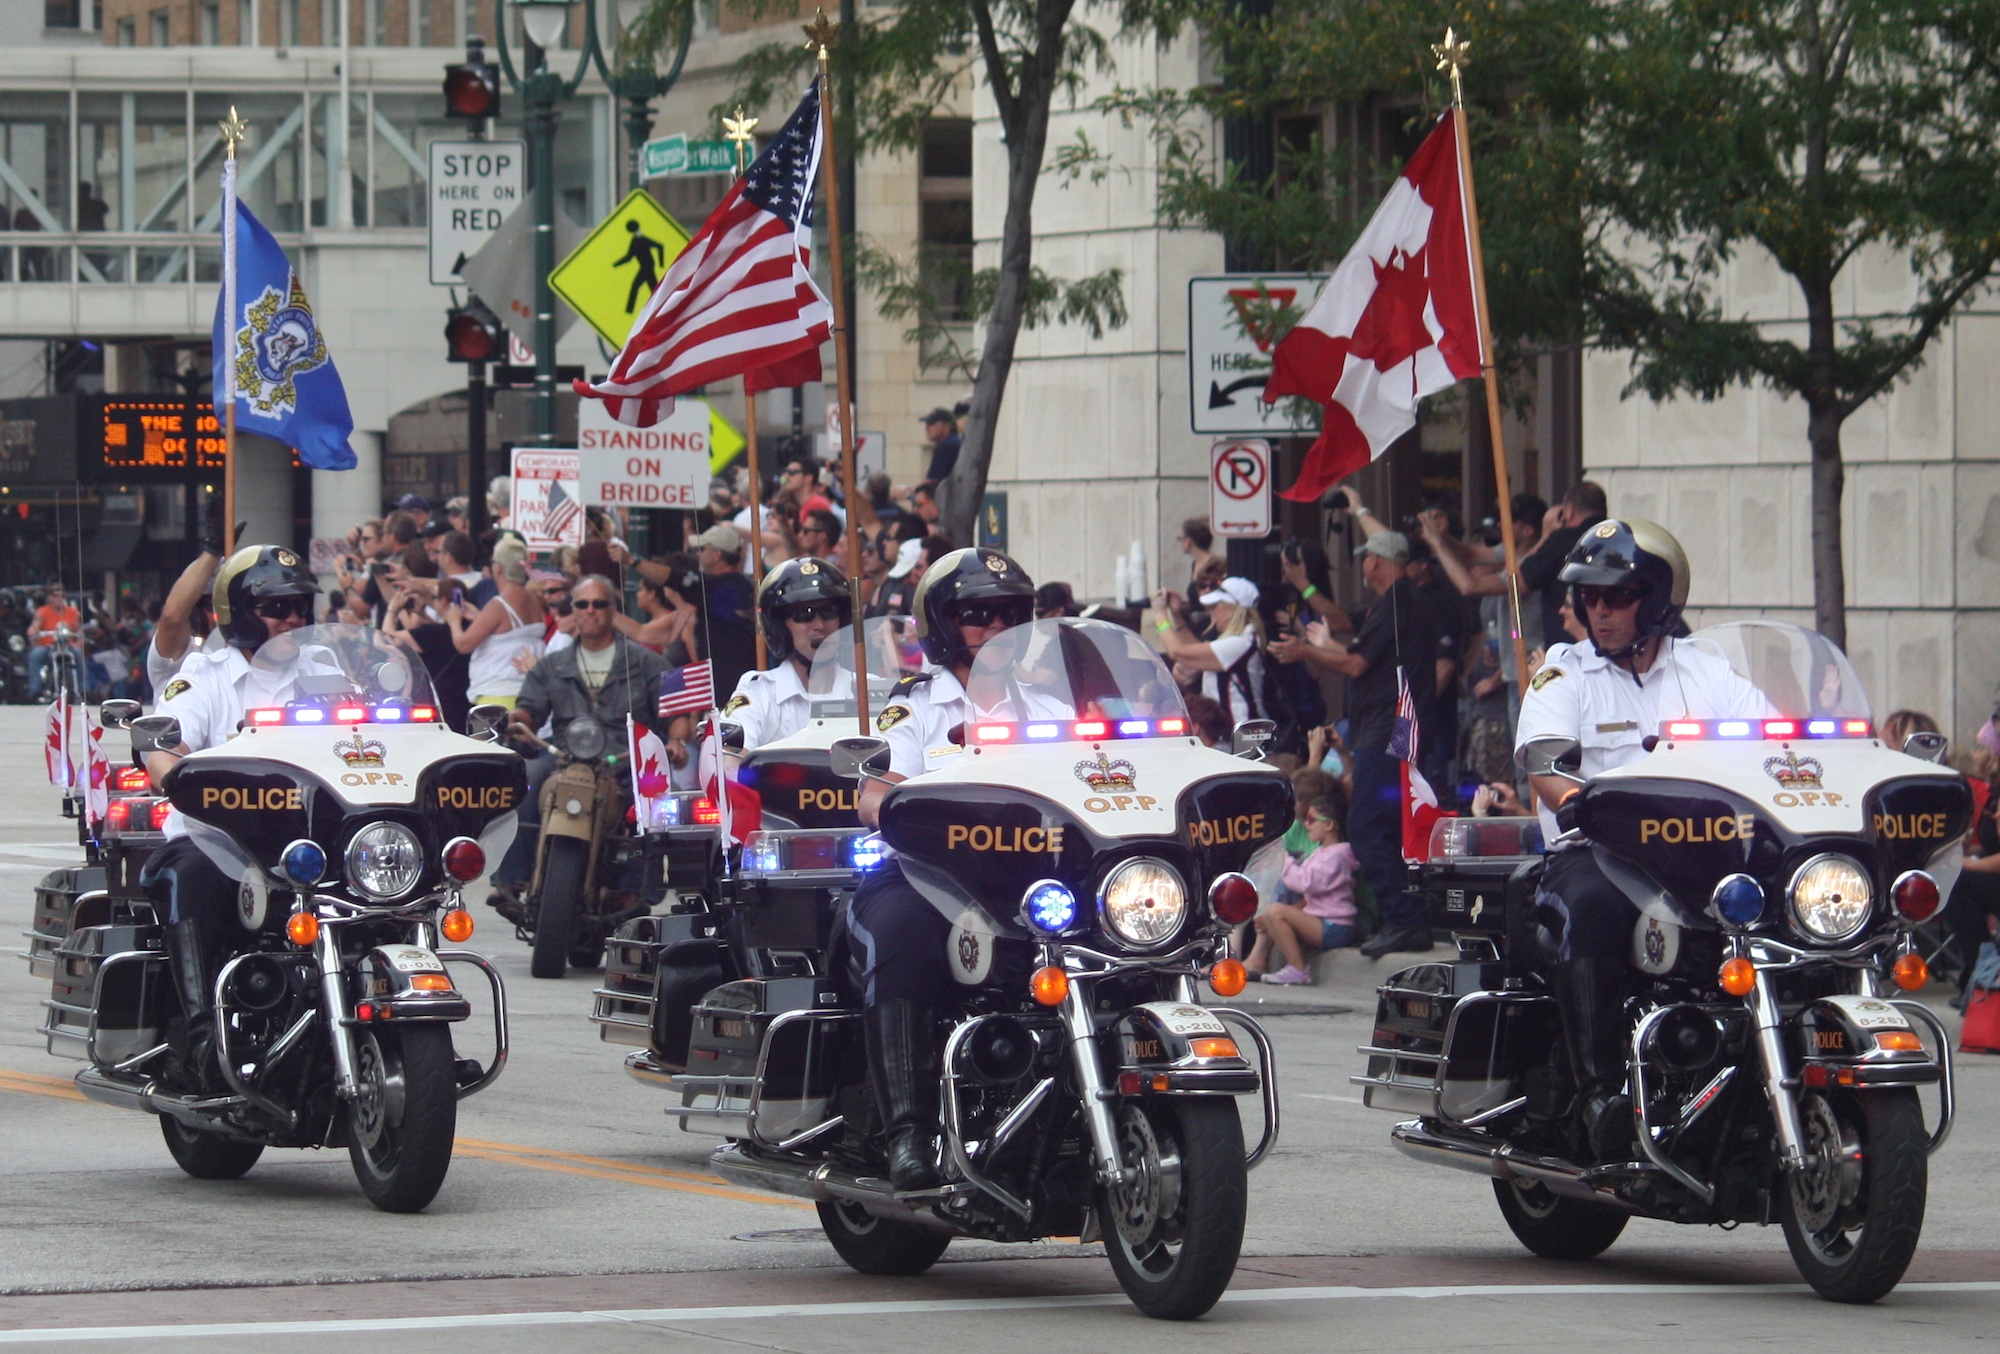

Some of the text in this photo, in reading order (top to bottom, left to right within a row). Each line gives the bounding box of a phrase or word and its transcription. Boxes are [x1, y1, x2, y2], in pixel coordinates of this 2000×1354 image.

[444, 154, 511, 177] STOP
[439, 185, 515, 199] HERE ON
[452, 208, 502, 230] RED
[140, 415, 183, 432] THE
[582, 429, 704, 451] STANDING
[626, 457, 661, 478] ON
[601, 482, 694, 504] BRIDGE
[340, 772, 409, 788] O.P.P.
[202, 787, 303, 811] POLICE
[437, 786, 513, 809] POLICE
[799, 789, 860, 811] POLI
[1083, 795, 1164, 813] O.P.P.
[1773, 791, 1850, 808] O.P.P.
[1188, 813, 1265, 847] POLICE
[1640, 813, 1755, 844] POLICE
[1873, 813, 1947, 840] POLICE
[948, 824, 1065, 853] POLICE
[1174, 1022, 1222, 1033] 8-280
[1129, 1039, 1159, 1059] POLICE
[1813, 1031, 1844, 1049] POLICE
